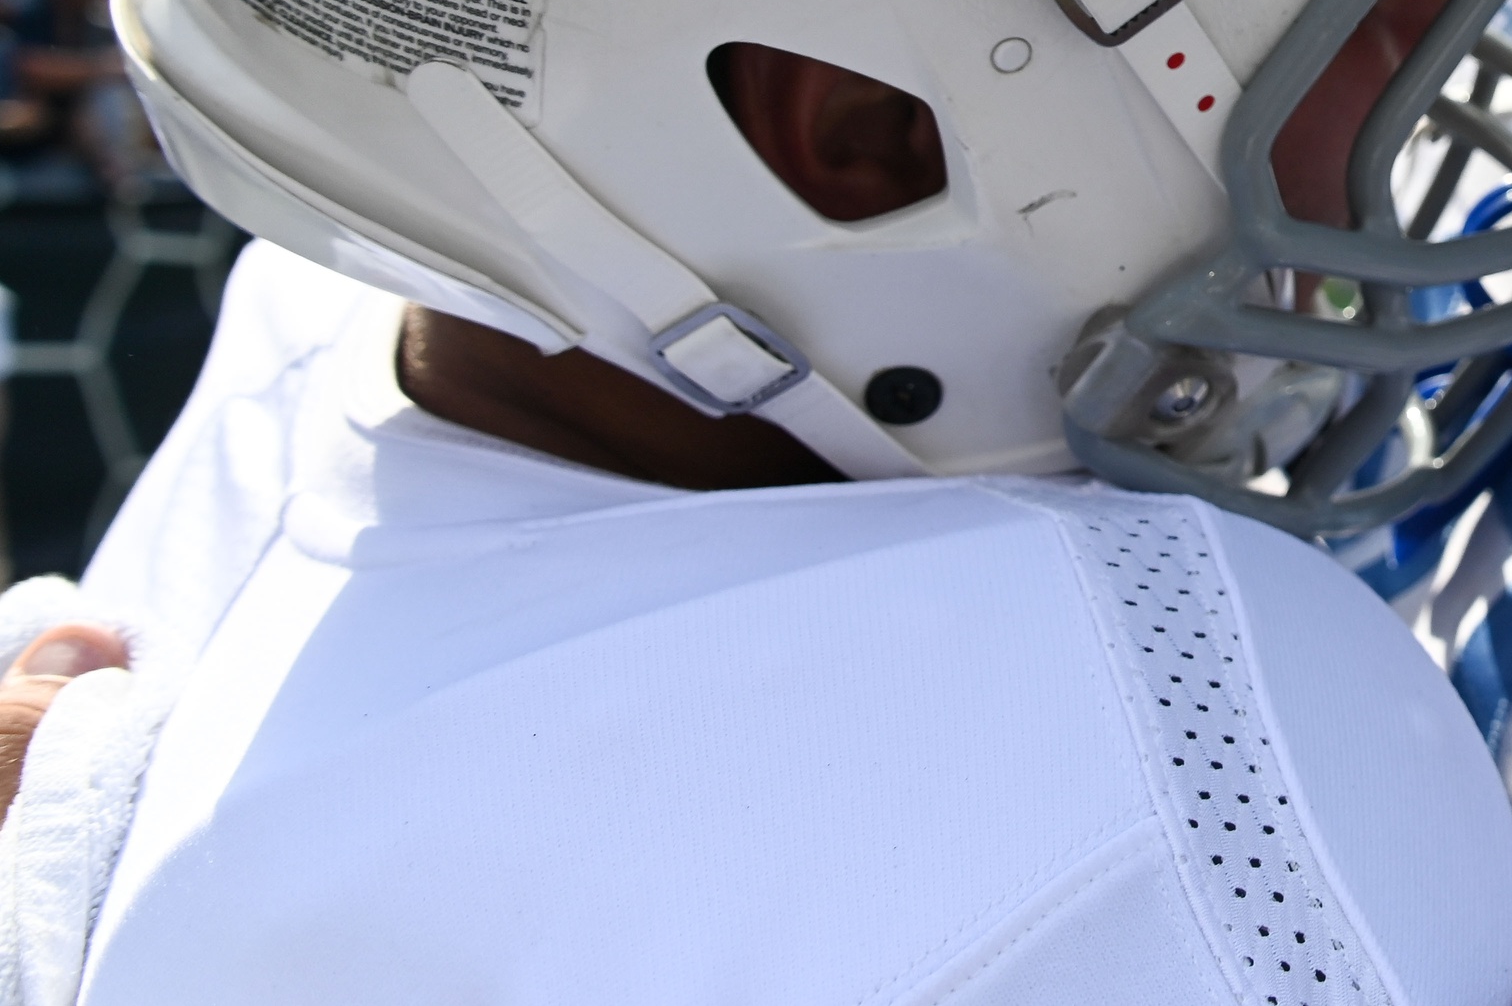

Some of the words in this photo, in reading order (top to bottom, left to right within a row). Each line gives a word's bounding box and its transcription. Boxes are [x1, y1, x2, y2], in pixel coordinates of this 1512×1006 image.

[413, 0, 422, 11] to
[424, 4, 446, 20] your
[448, 11, 499, 35] opponent.
[461, 2, 487, 19] head
[489, 11, 500, 22] or
[502, 13, 528, 29] neck
[510, 4, 518, 14] is
[521, 6, 531, 18] in
[372, 8, 380, 20] of
[381, 12, 449, 44] consciousness
[453, 37, 462, 47] or
[444, 21, 485, 42] INJURY
[487, 34, 514, 50] which
[516, 42, 529, 53] no
[471, 53, 532, 80] immediately
[482, 80, 498, 92] ou
